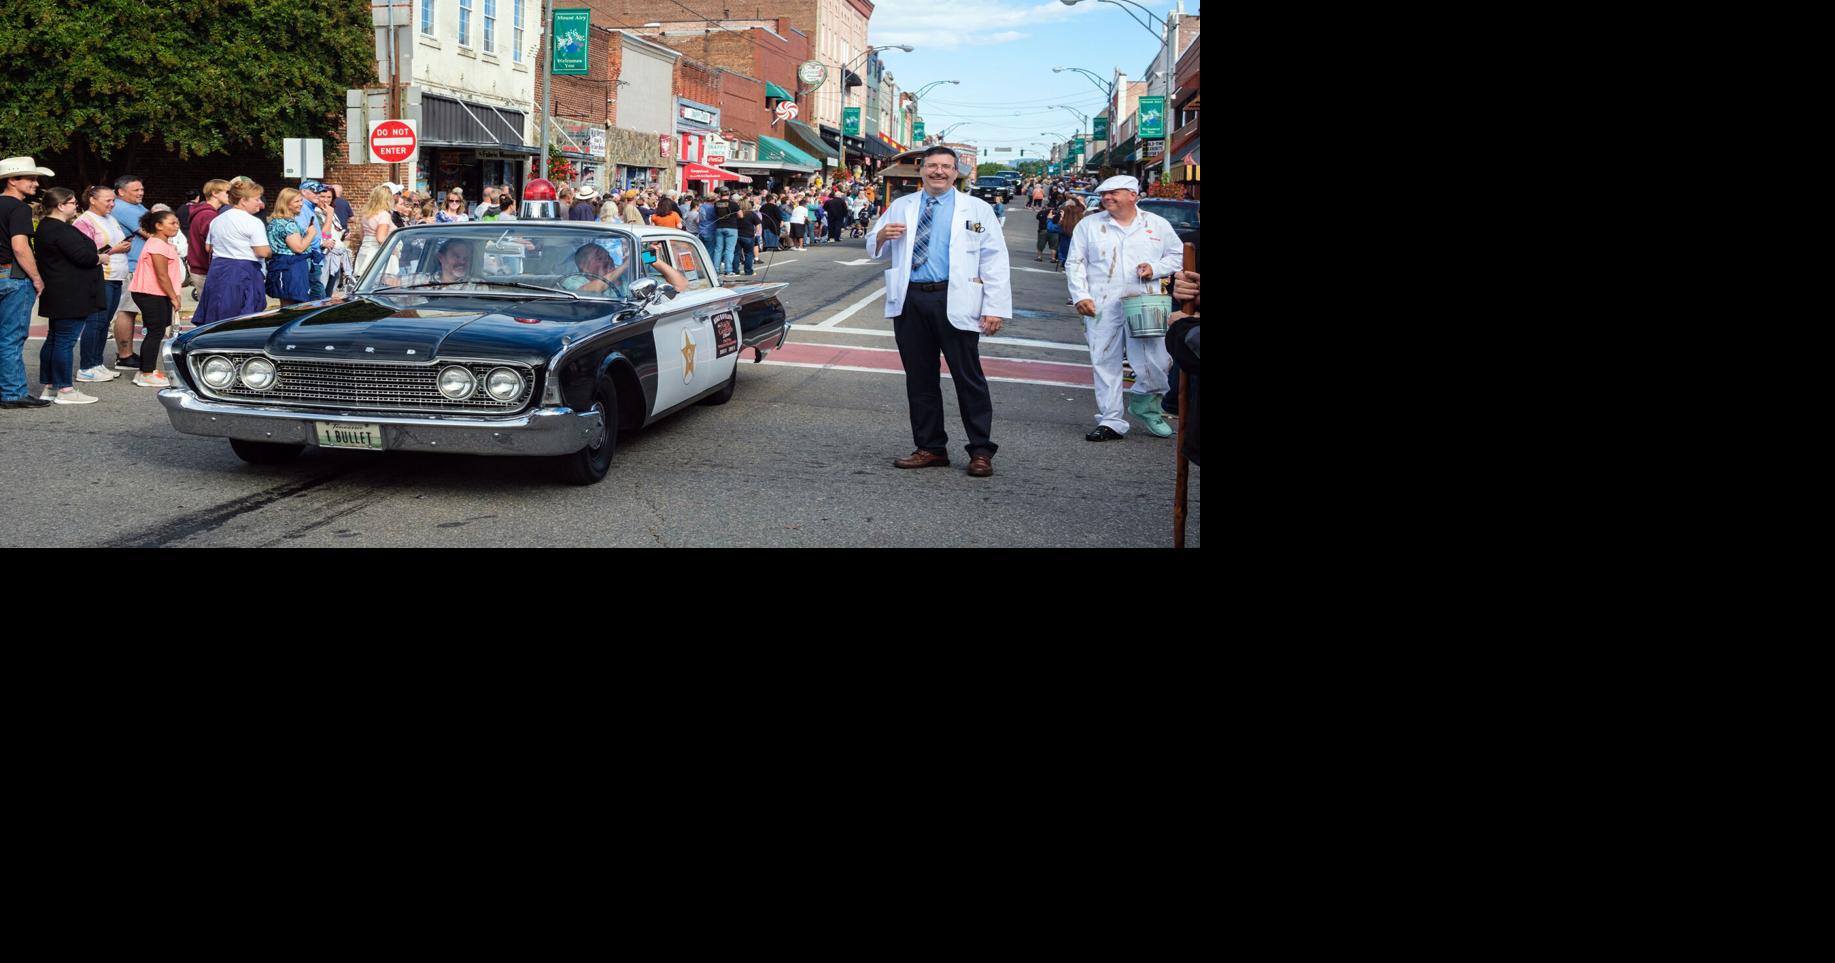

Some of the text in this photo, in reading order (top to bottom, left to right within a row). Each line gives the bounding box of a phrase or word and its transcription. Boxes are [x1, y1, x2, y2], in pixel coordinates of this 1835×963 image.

[376, 128, 409, 136] DO NOT
[380, 147, 407, 155] ENTER
[286, 344, 416, 355] FORD
[325, 430, 372, 446] 1 BULLET
